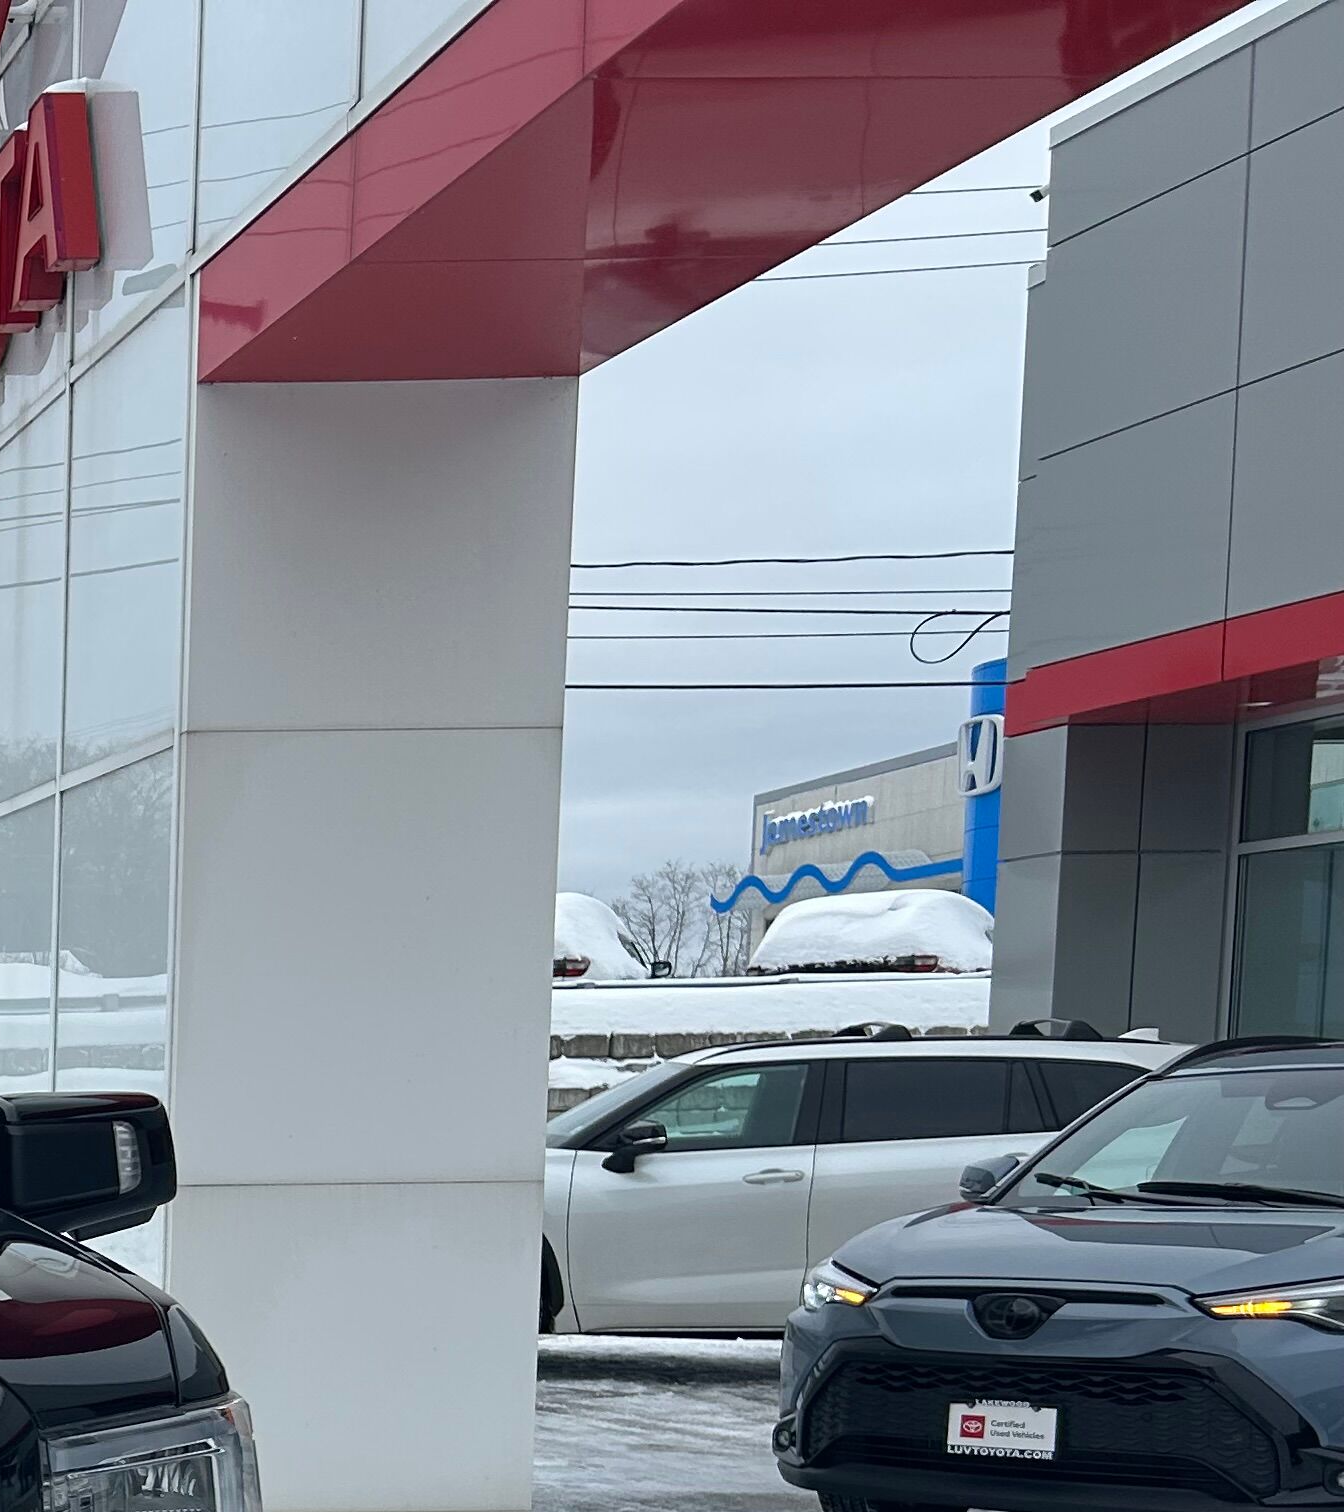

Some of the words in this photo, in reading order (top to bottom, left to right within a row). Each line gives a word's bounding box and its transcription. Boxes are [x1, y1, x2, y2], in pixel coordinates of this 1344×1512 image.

[975, 1399, 1031, 1408] LAKEWOOD
[990, 1420, 1026, 1429] Certified
[947, 1445, 1054, 1460] LUVTOYOTA.COM
